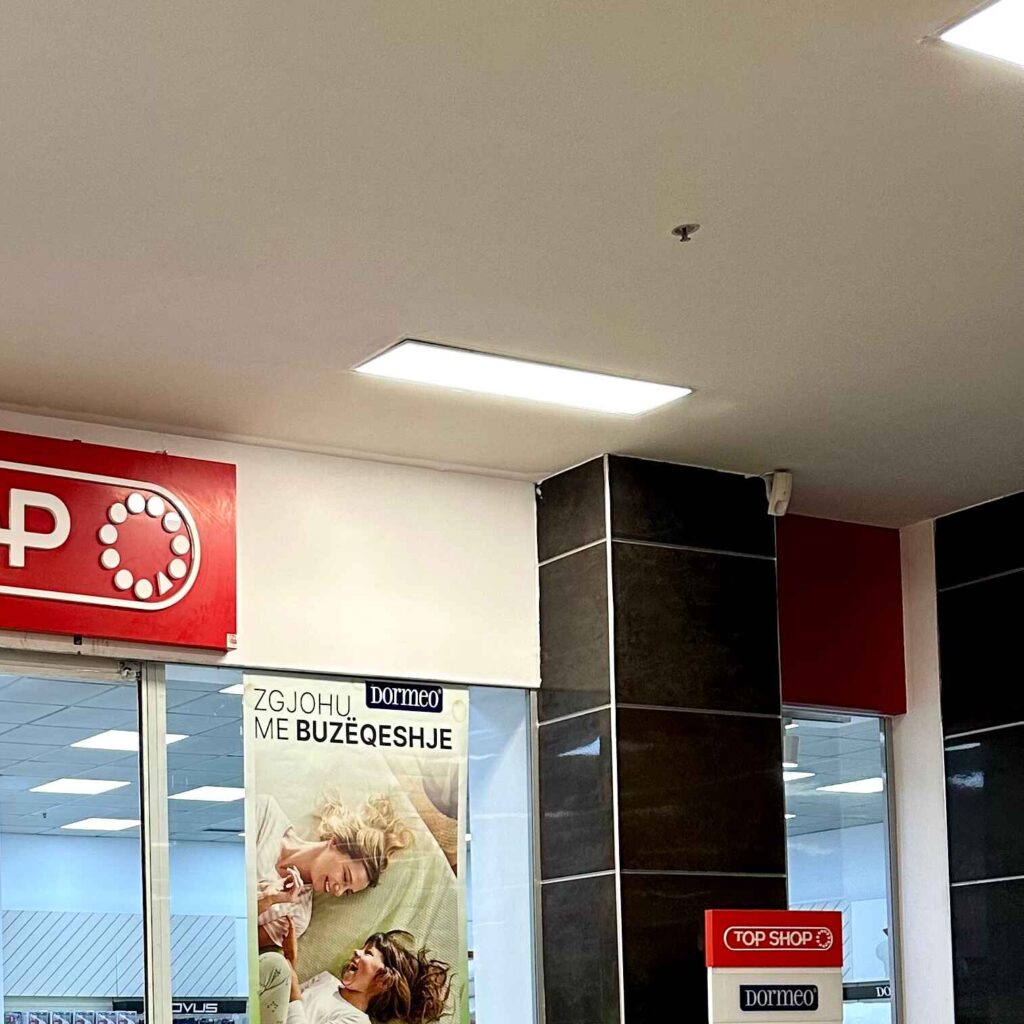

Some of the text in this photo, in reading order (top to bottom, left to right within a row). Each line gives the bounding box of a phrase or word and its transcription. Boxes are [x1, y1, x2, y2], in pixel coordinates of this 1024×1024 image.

[253, 688, 351, 717] ZGJOHU
[370, 686, 439, 708] Dormeo
[254, 716, 453, 750] ME BUZËQESHJE
[733, 930, 813, 947] TOP SHOP
[744, 988, 815, 1007] Dormeo
